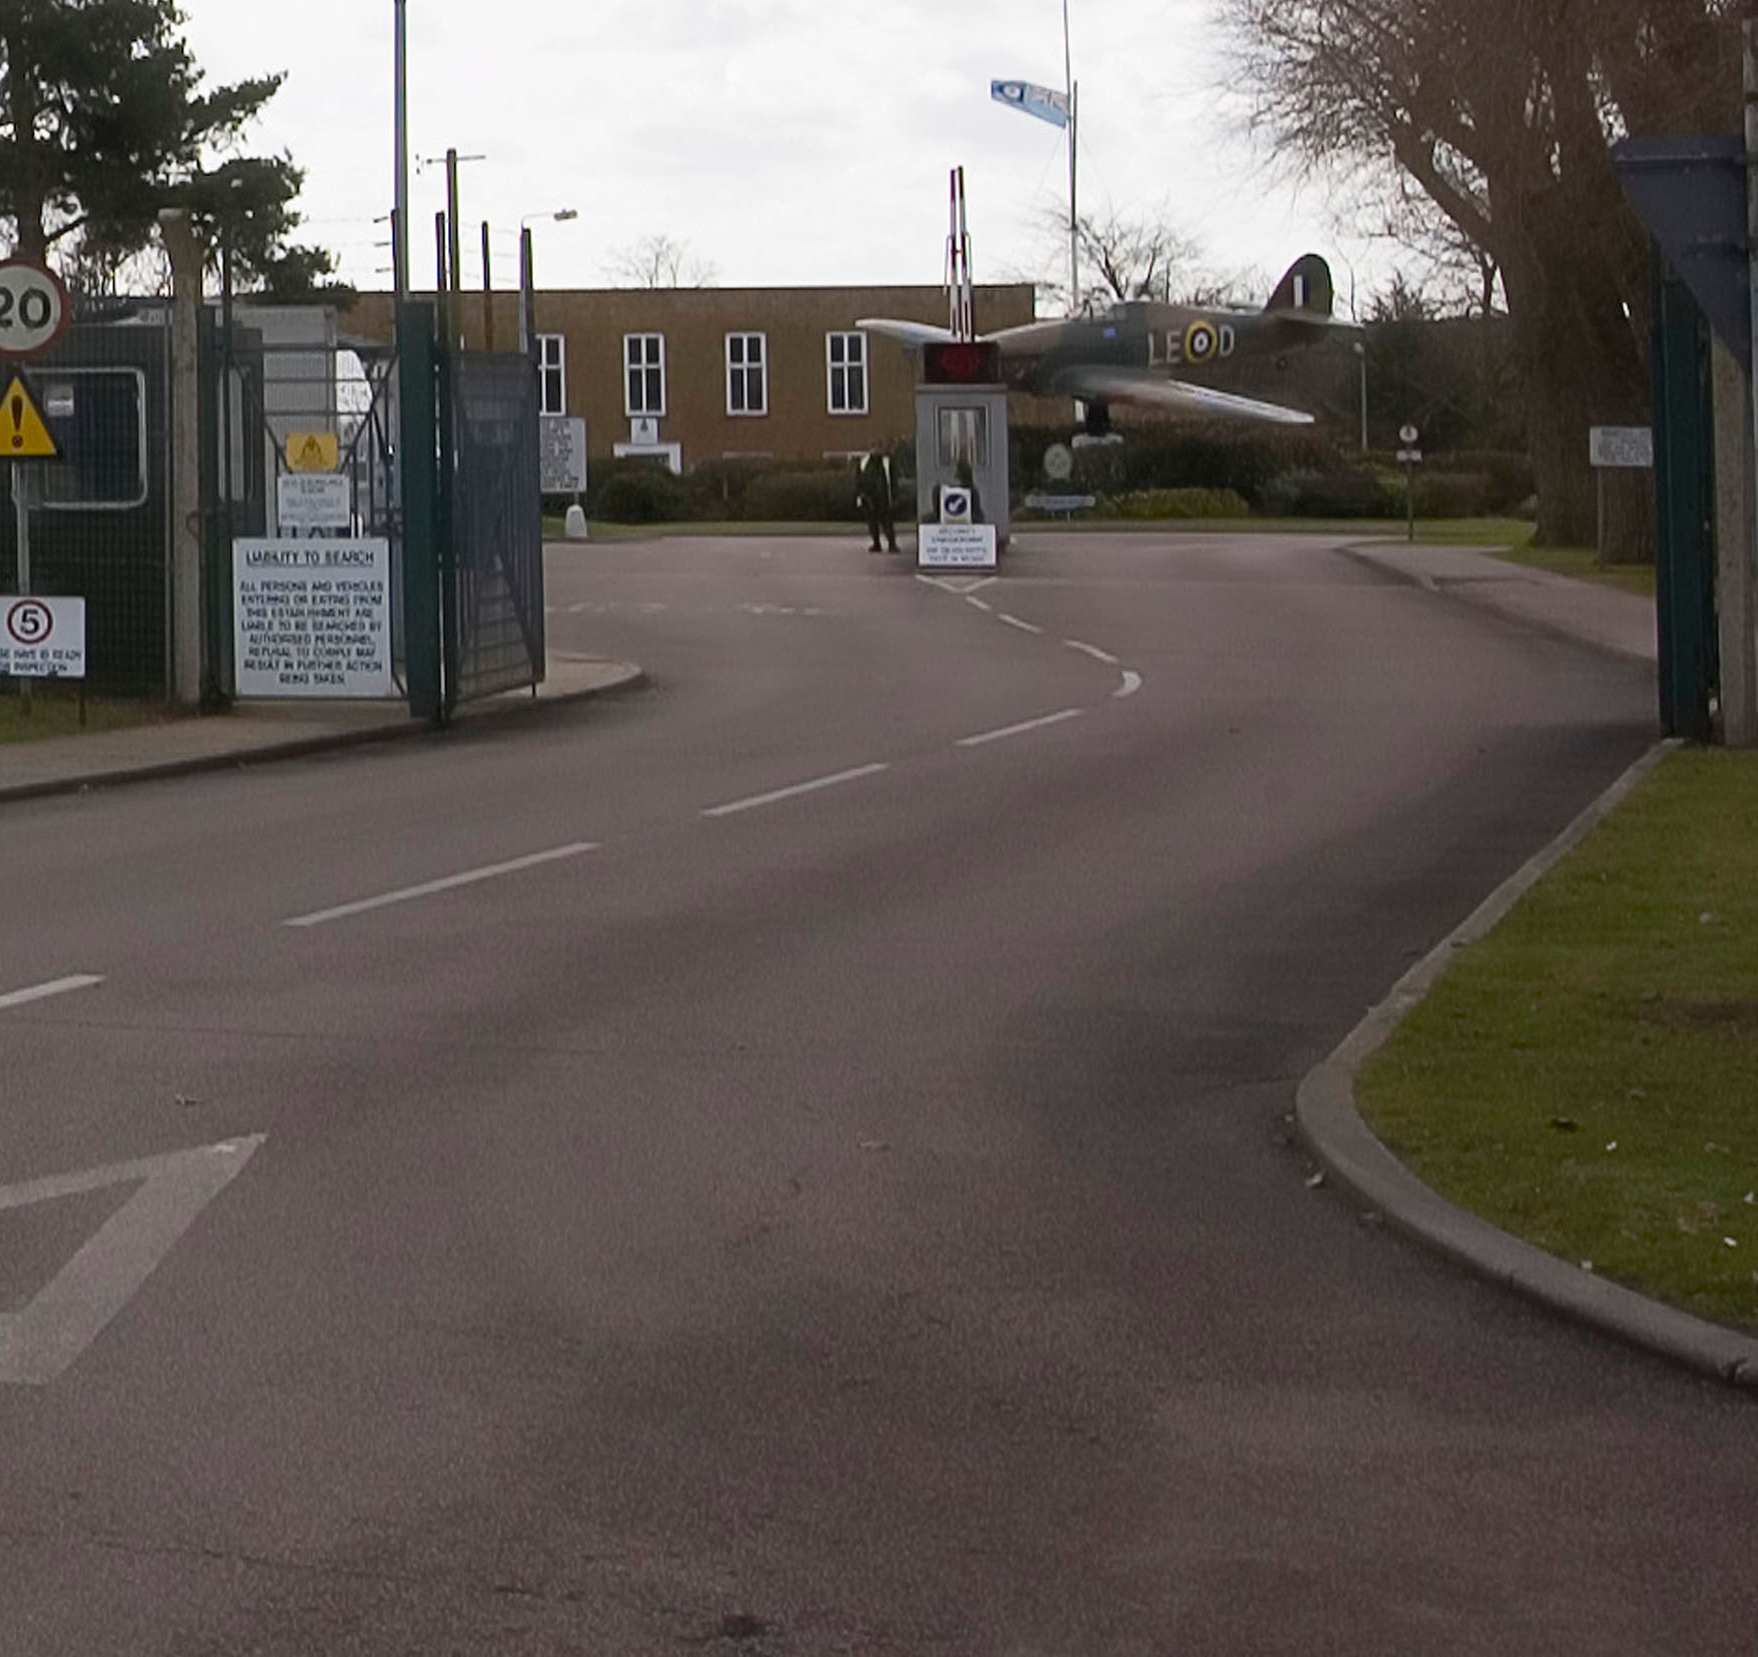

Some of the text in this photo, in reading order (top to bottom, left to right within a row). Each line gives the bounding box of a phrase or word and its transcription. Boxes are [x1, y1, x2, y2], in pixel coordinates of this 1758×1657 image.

[1148, 324, 1235, 364] LE D
[306, 550, 320, 564] TO
[326, 550, 375, 564] SEARCH
[261, 581, 307, 592] PERSONS
[312, 581, 332, 592] AND
[20, 608, 40, 635] 5
